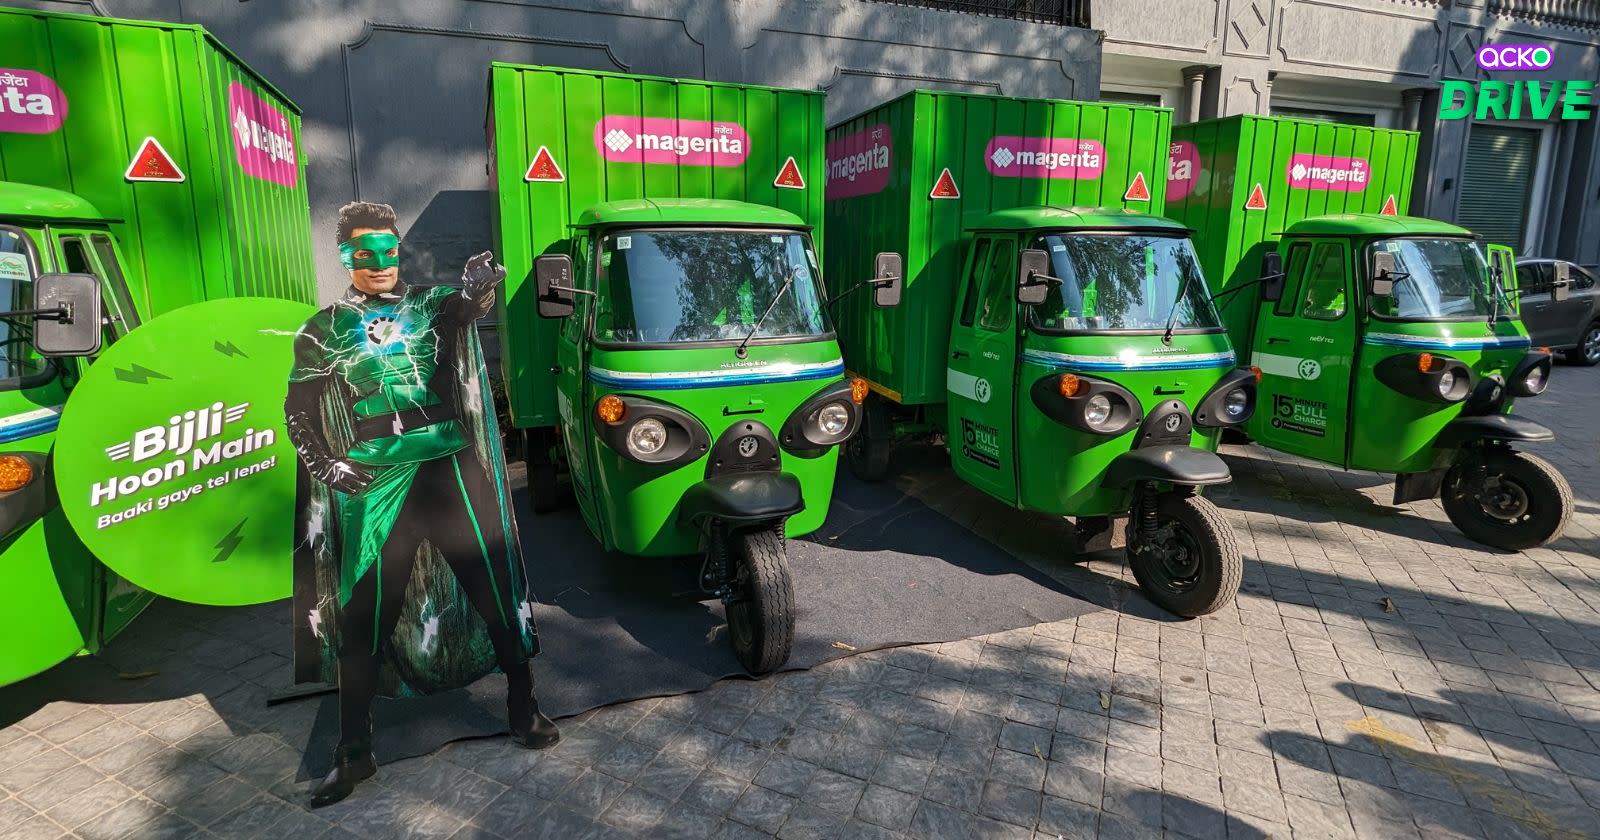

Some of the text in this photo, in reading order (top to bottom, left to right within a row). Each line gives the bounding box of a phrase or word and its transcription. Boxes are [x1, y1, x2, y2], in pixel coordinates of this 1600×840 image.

[635, 132, 742, 156] magenta
[831, 142, 889, 182] magenta
[1016, 151, 1100, 170] magenta
[1307, 167, 1366, 184] magenta
[1272, 393, 1294, 418] 15
[1294, 397, 1328, 410] MINUTE
[1294, 404, 1327, 419] FULL
[1294, 414, 1327, 427] CHARGE
[133, 401, 224, 463] Bijli
[976, 429, 1000, 449] FULL
[89, 428, 276, 507] Hoon Main
[97, 455, 277, 529] Baaki gaye tel lene!
